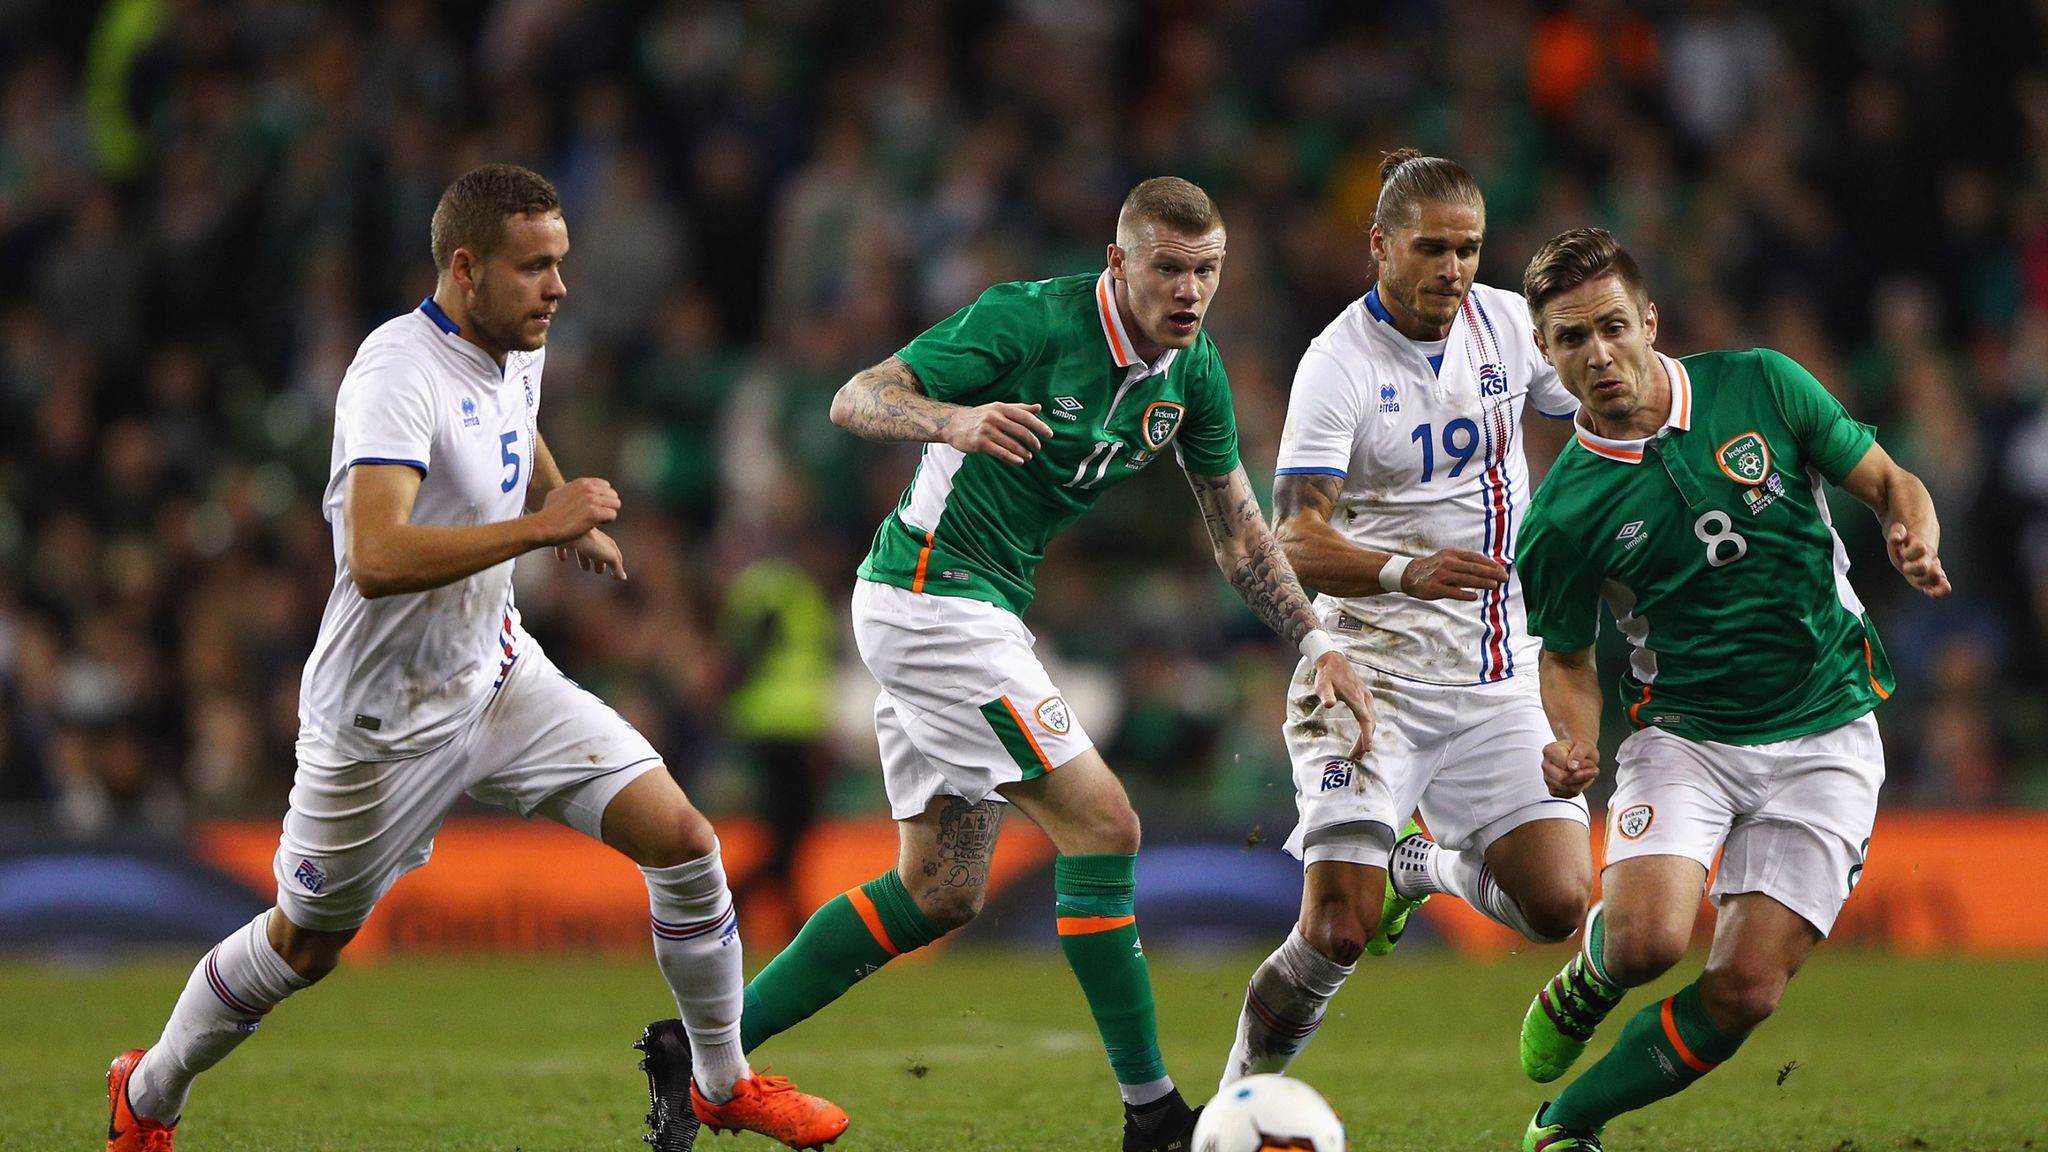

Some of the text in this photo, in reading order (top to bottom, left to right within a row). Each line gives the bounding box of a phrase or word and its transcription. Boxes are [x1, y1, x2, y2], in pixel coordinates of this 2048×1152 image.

[1052, 408, 1077, 421] umbro
[1155, 408, 1178, 420] Ireland
[500, 430, 520, 494] 5
[1062, 441, 1124, 490] 11
[1411, 417, 1480, 483] 19
[1726, 438, 1755, 459] Ireland
[1624, 532, 1648, 550] umbro
[1694, 510, 1747, 567] 8
